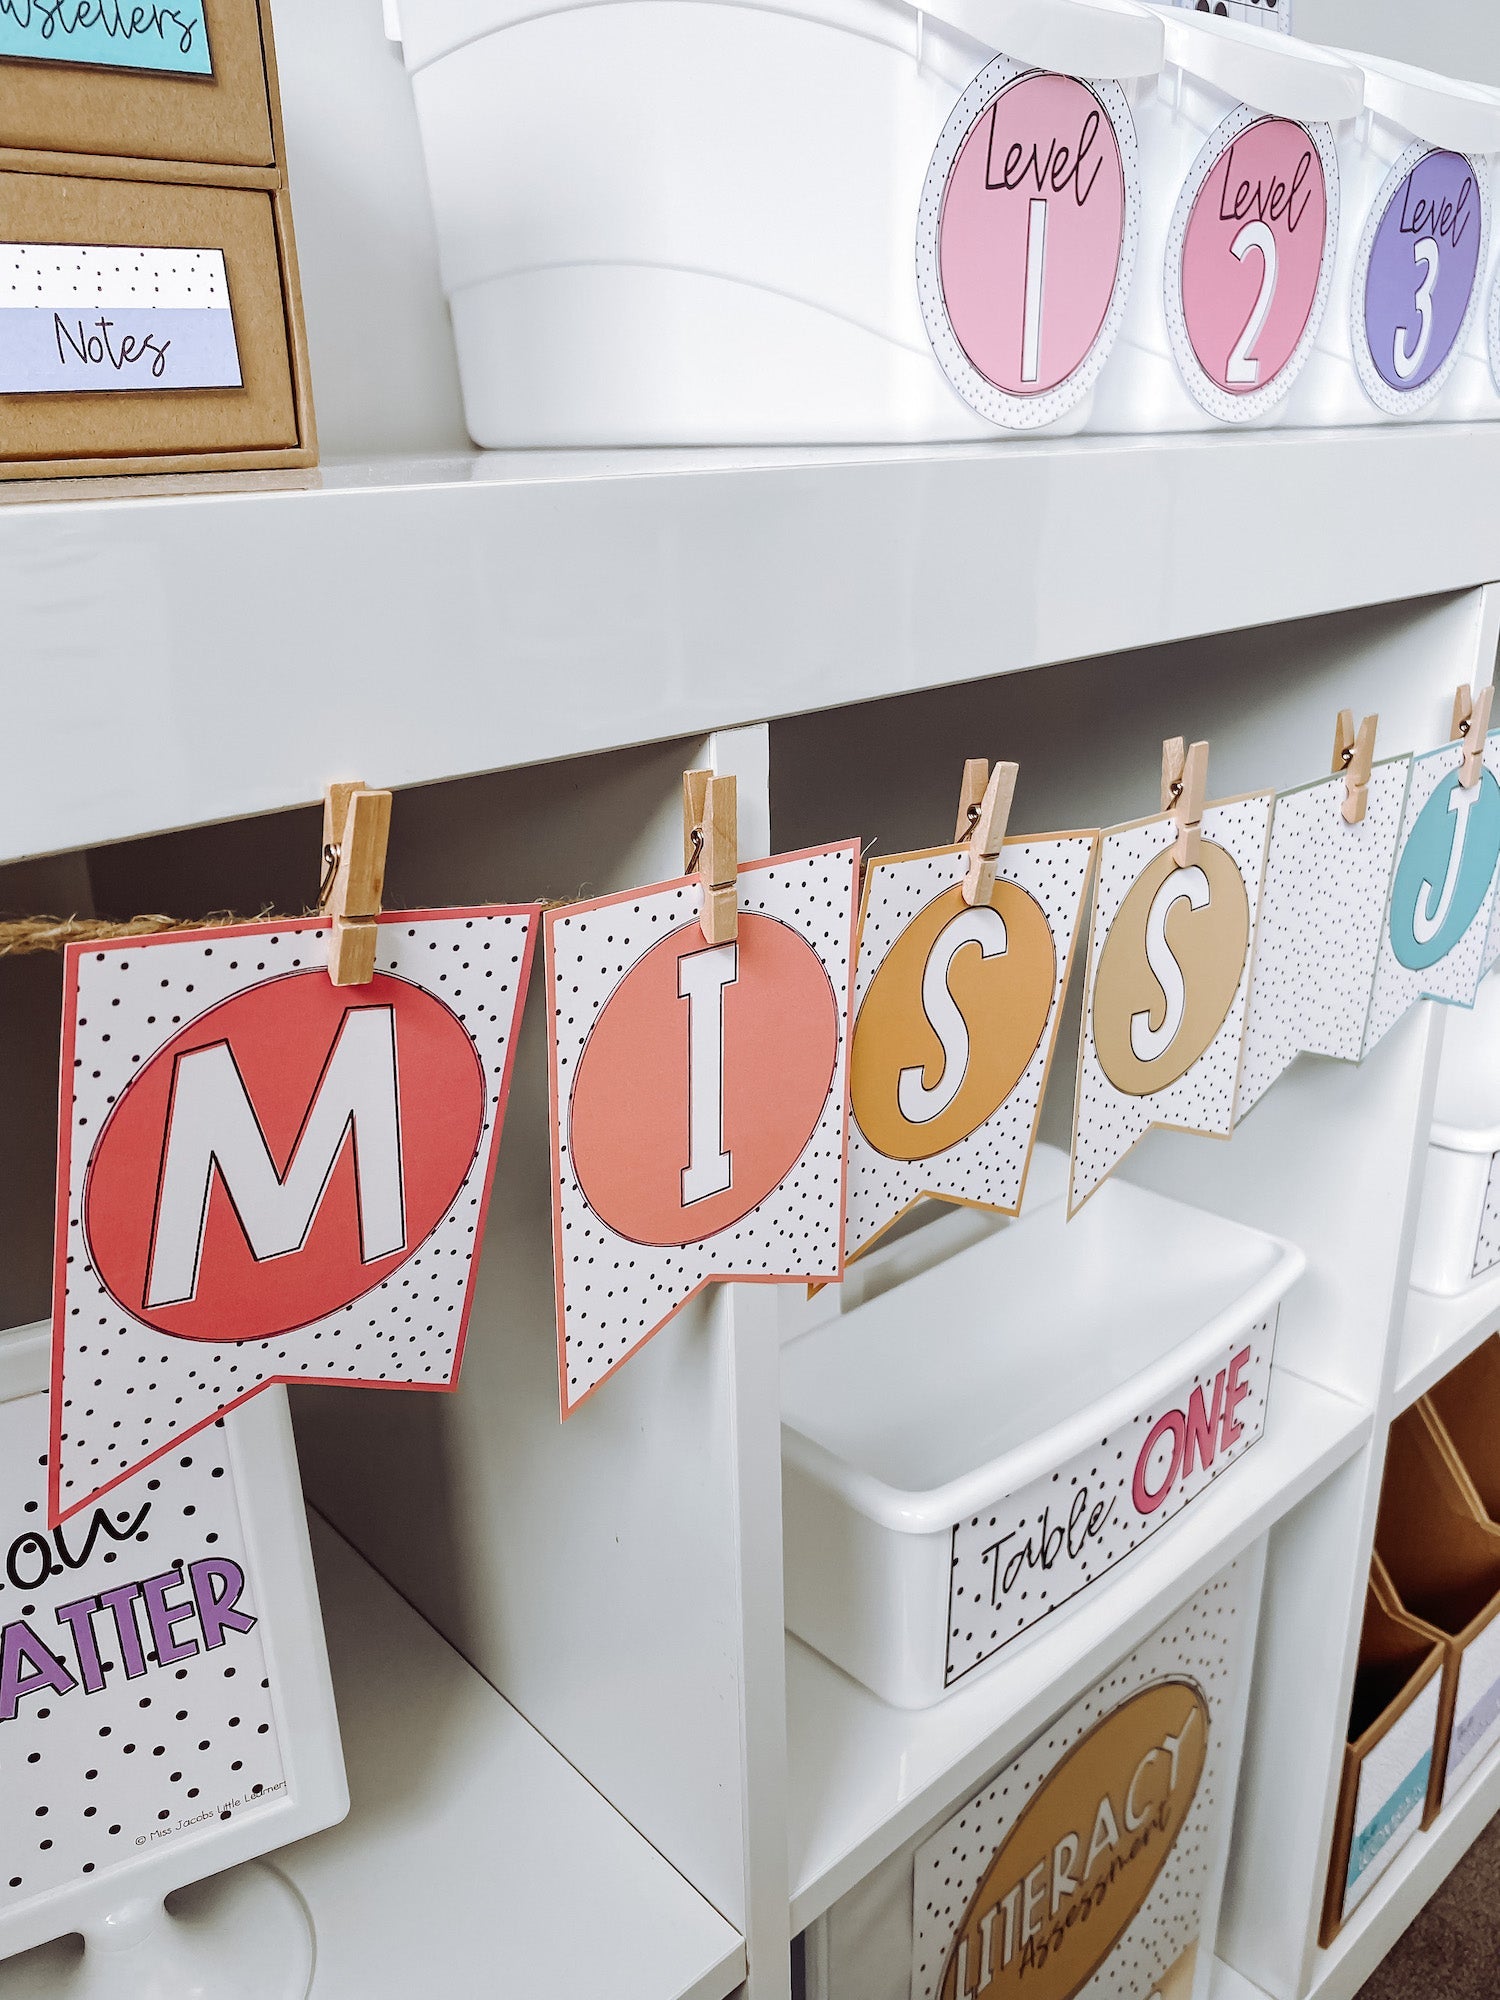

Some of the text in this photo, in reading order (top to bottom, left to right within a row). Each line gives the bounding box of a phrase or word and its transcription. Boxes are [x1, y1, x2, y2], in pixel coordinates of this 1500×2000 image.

[984, 103, 1103, 207] Level
[1219, 146, 1312, 233] Level
[1399, 169, 1473, 248] Level
[53, 312, 172, 378] Notes
[1020, 198, 1048, 384] 1
[1226, 219, 1277, 384] 2
[1392, 235, 1441, 381] 3
[1412, 776, 1484, 945] J
[980, 1344, 1251, 1607] Table ONE
[0, 1556, 258, 1723] ATTER
[149, 1828, 172, 1841] Miss
[175, 1809, 214, 1831] Jacobs
[216, 1797, 241, 1815] Little
[953, 1705, 1199, 2000] LITERACY
